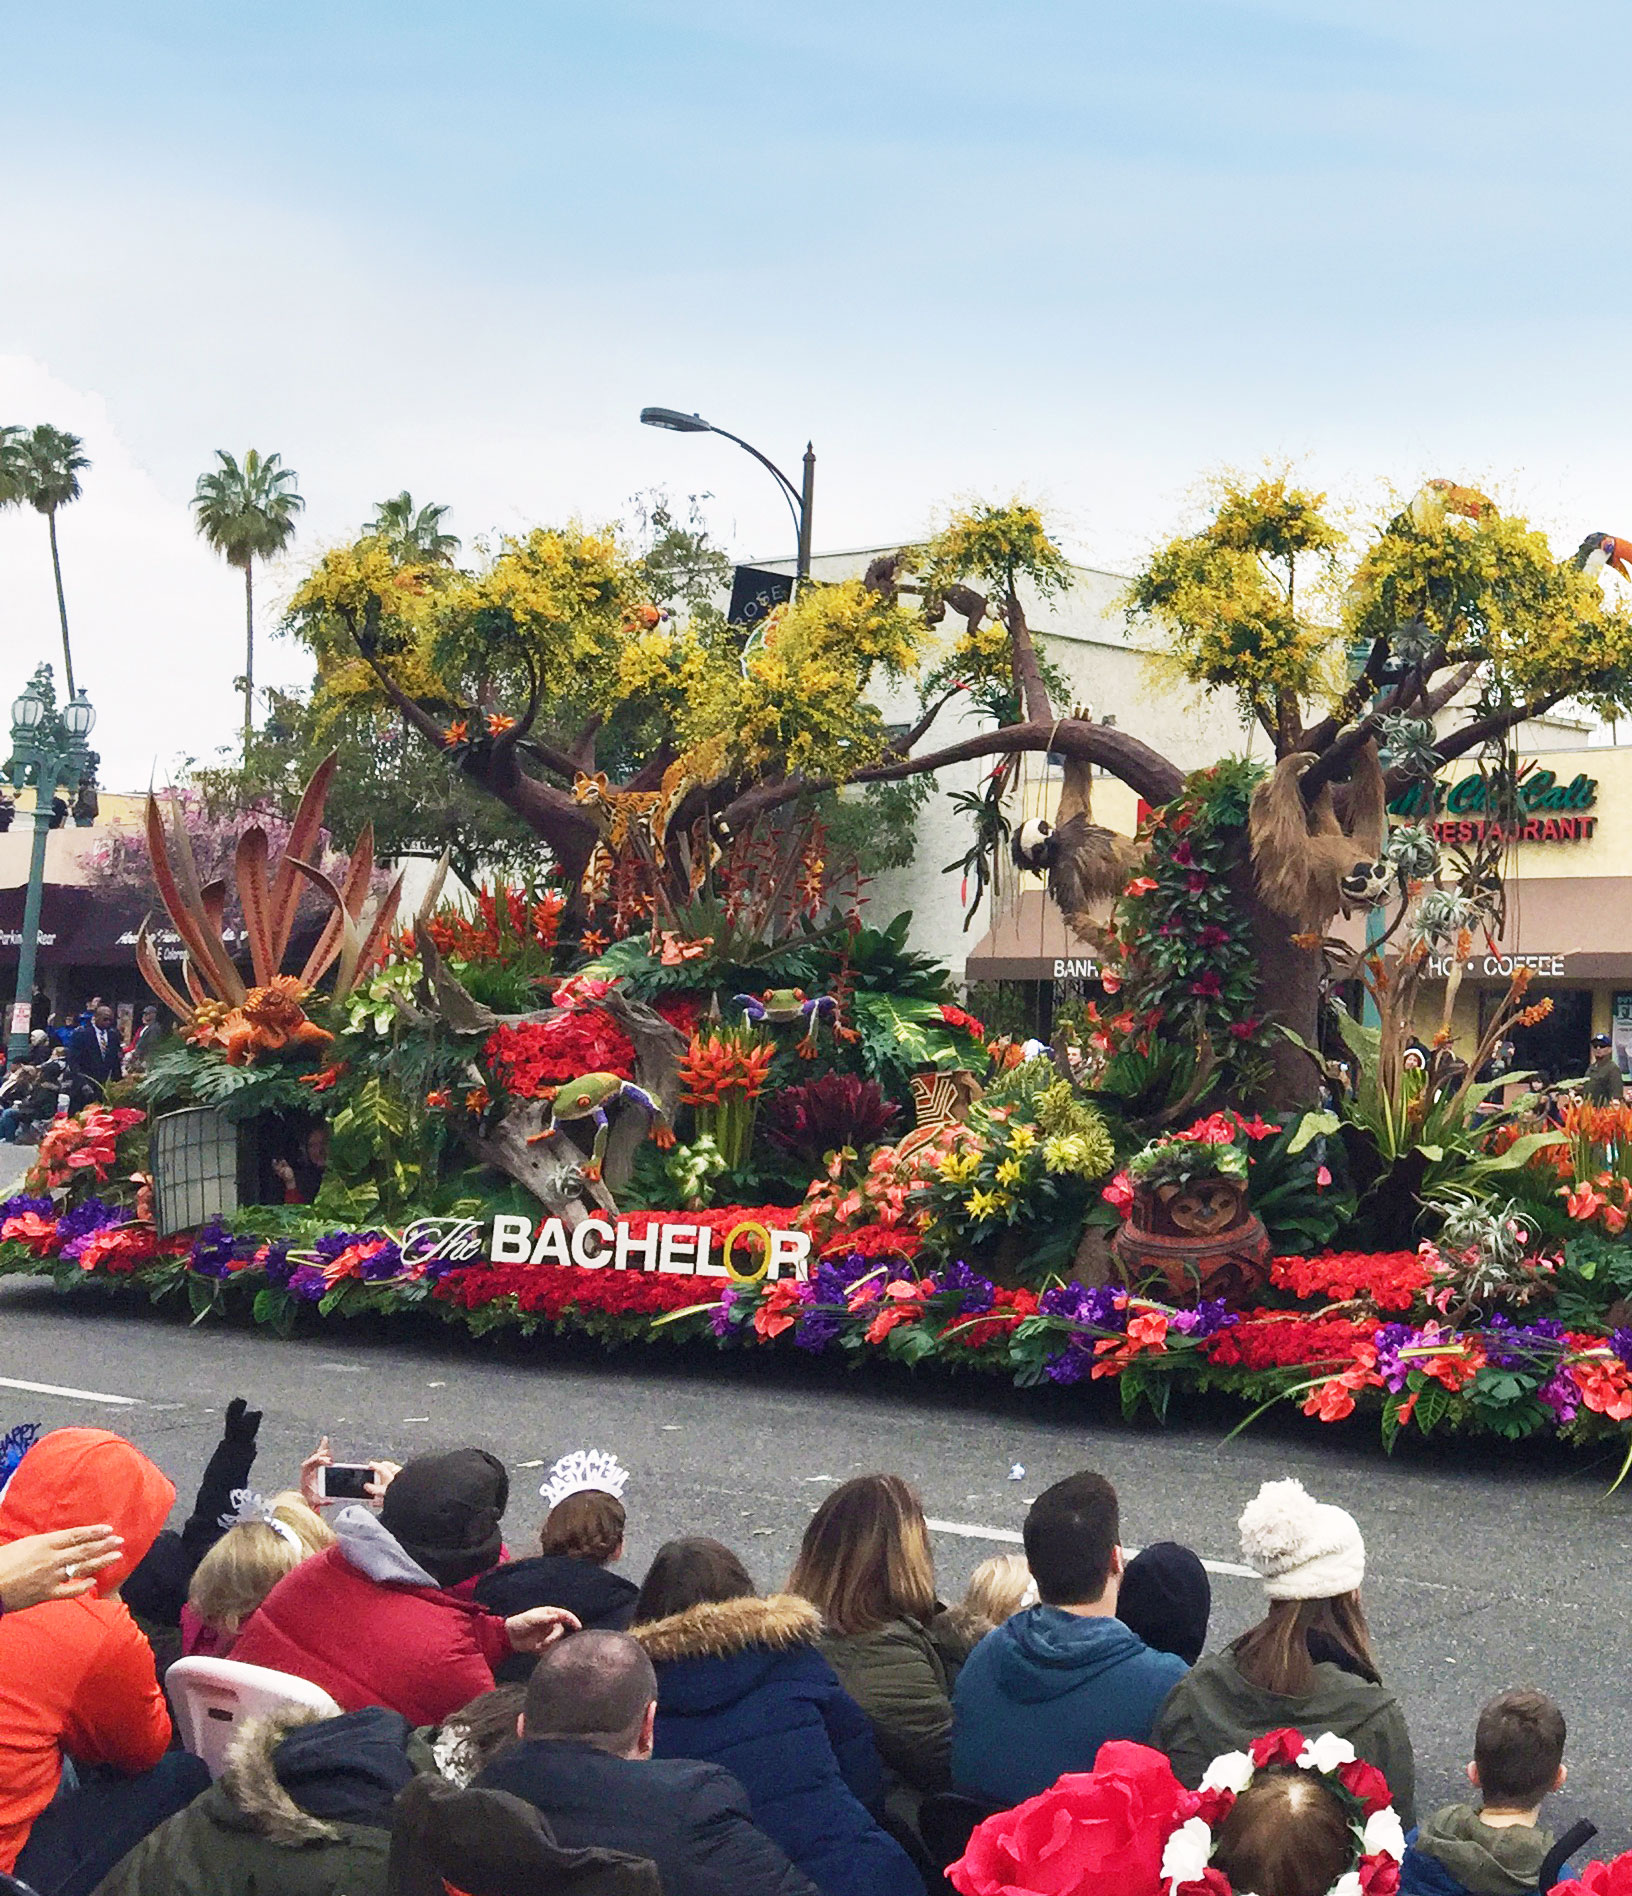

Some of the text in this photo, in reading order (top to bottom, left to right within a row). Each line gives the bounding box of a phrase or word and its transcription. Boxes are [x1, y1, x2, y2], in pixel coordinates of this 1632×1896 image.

[0, 929, 24, 945] Parkin
[163, 947, 191, 960] Colora
[1484, 955, 1565, 977] COFFEE
[399, 1214, 811, 1284] The BACHELOR
